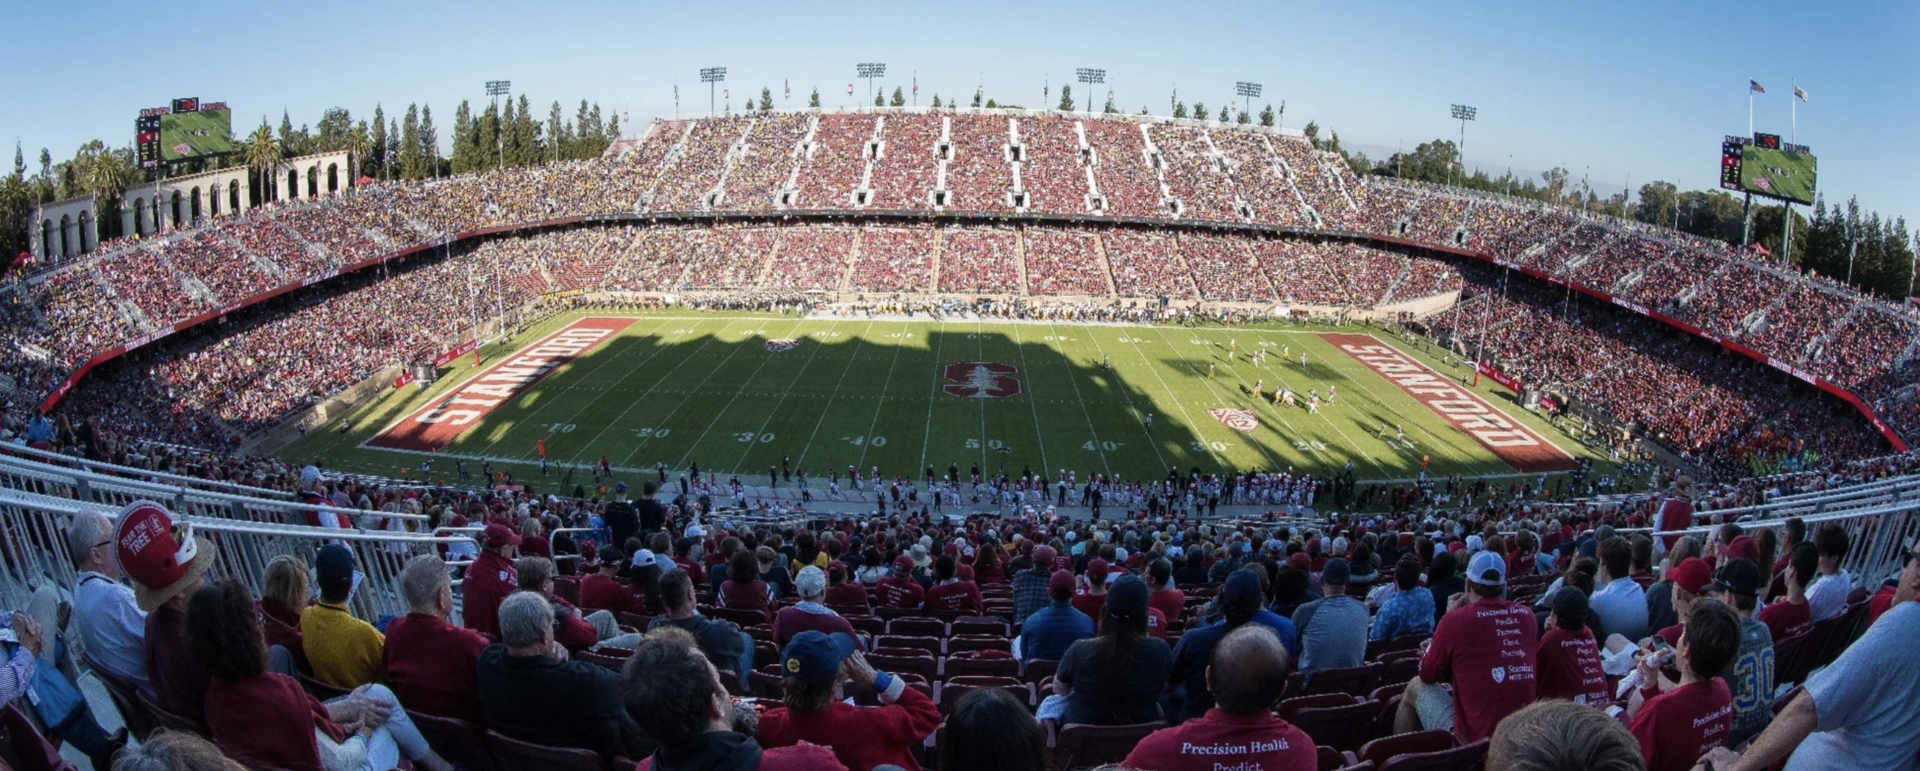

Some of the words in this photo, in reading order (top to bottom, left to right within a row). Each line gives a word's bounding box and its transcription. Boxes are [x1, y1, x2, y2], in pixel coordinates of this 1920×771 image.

[415, 327, 614, 425] STANFORD
[1341, 344, 1540, 447] STANFORD
[547, 422, 577, 433] 10
[634, 427, 670, 438] 20
[737, 431, 775, 443] 30
[849, 435, 887, 447] 40
[965, 438, 1004, 449] 50
[1081, 440, 1118, 451] 40
[1191, 441, 1227, 452] 30
[1293, 440, 1326, 451] 20
[121, 530, 137, 548] FEAR
[134, 520, 148, 533] THE
[128, 531, 152, 556] TREE
[1733, 646, 1775, 713] 30
[1181, 742, 1247, 755] Precision
[1250, 738, 1289, 753] Health
[1213, 762, 1264, 771] Predict.
